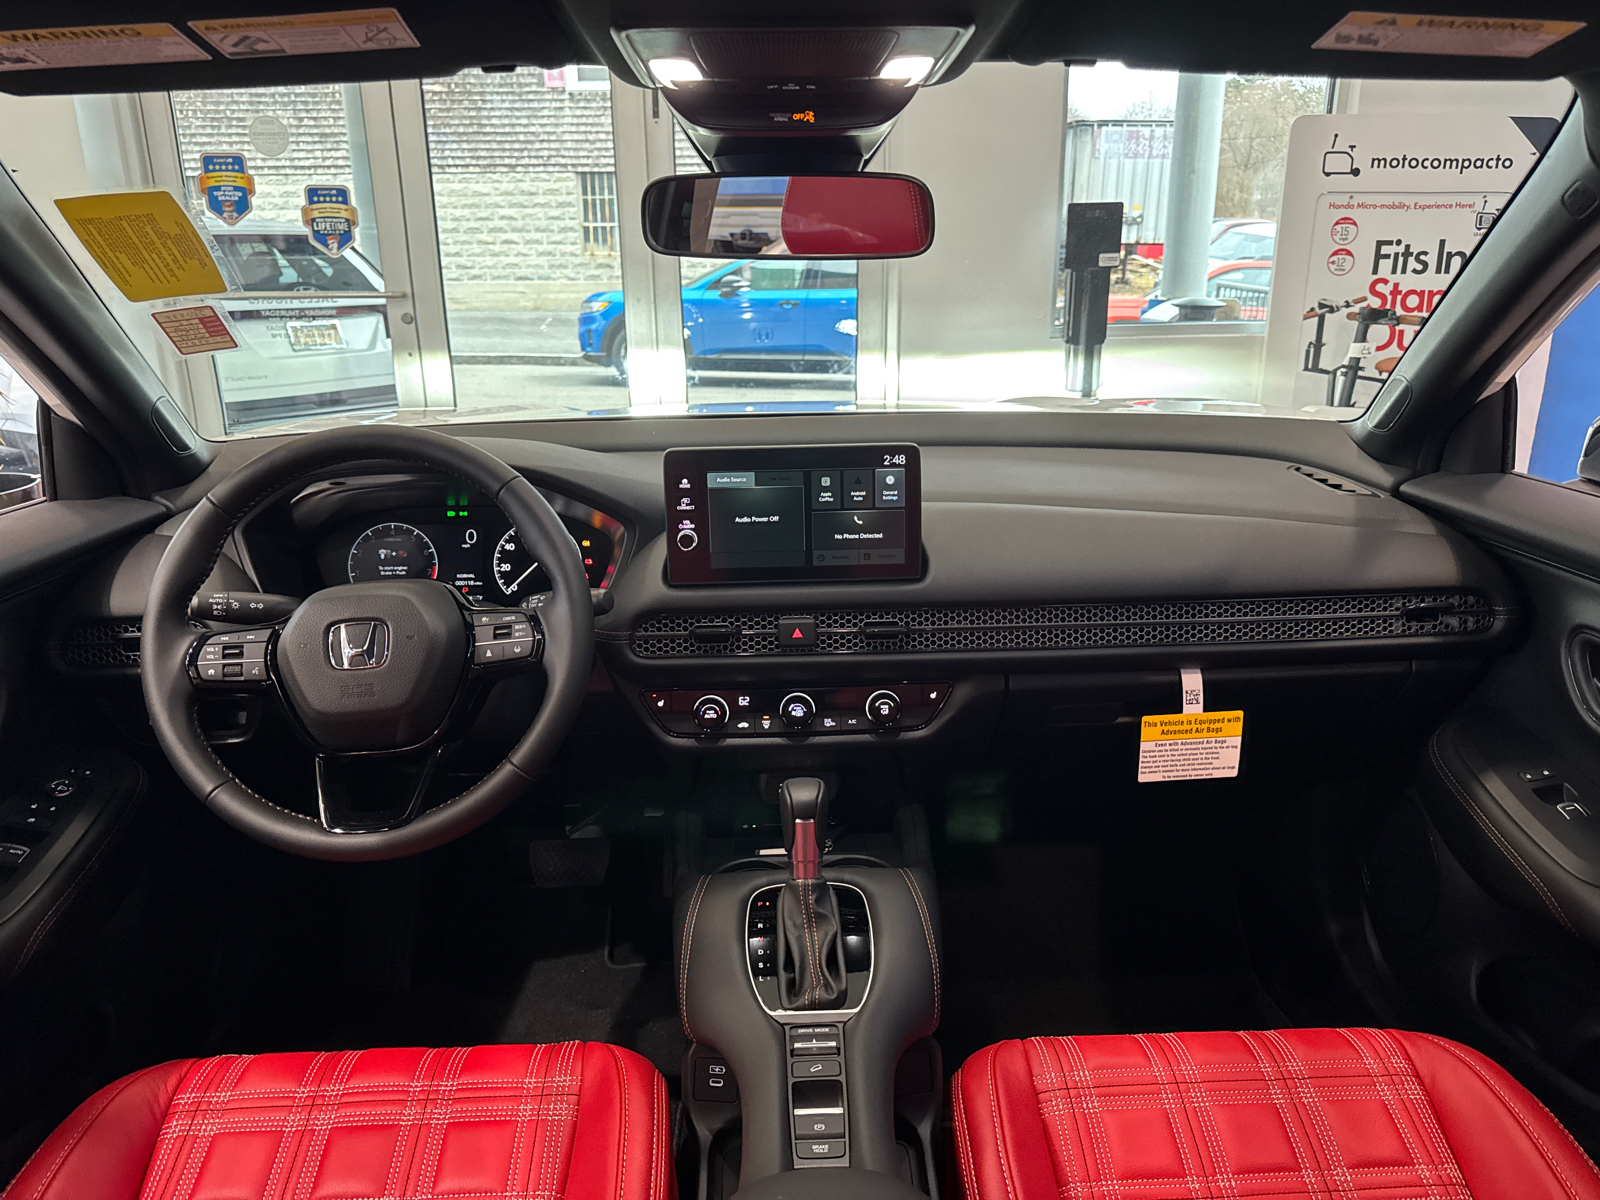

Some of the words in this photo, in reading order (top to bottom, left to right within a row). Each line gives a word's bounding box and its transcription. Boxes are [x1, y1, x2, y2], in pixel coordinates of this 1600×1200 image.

[1417, 19, 1544, 32] WARNING
[8, 27, 142, 42] WARNING
[1370, 154, 1514, 175] motocompacto
[1328, 202, 1355, 210] Honda
[1356, 202, 1412, 212] Micro-mobility.
[1413, 202, 1453, 211] Experience
[313, 222, 349, 230] LIFETIME
[1340, 226, 1349, 236] 15
[1336, 257, 1346, 267] 12
[1371, 239, 1430, 275] Fits
[883, 455, 906, 465] 2:48
[465, 529, 477, 544] 0
[504, 543, 515, 551] 40
[500, 563, 511, 571] 20
[739, 697, 750, 706] 62
[1160, 719, 1184, 727] Vehicle
[1194, 716, 1225, 726] Equipped
[1227, 715, 1241, 723] with
[1161, 728, 1193, 736] Advanced
[1206, 726, 1223, 734] Bags
